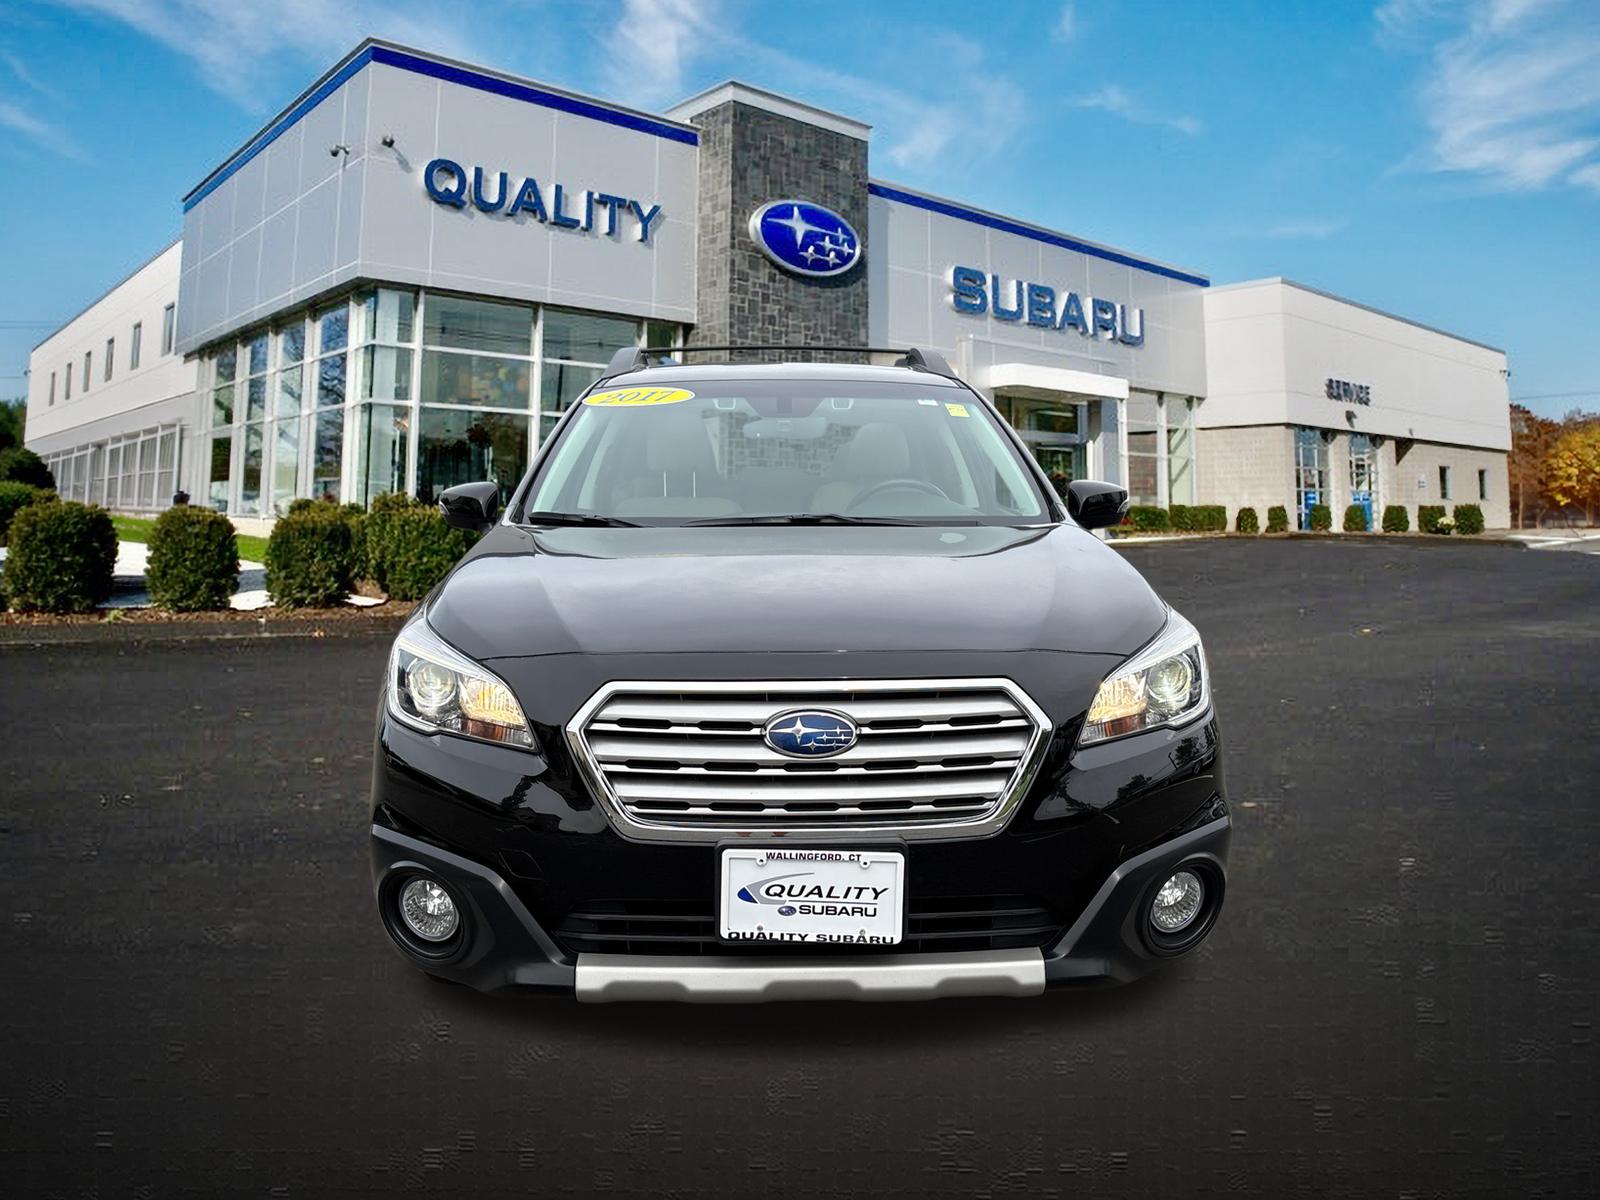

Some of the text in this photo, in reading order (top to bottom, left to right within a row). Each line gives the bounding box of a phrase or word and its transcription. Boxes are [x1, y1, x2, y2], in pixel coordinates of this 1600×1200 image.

[423, 158, 661, 243] QUALITY
[948, 265, 1145, 346] SUBARU
[599, 390, 677, 404] 2017
[848, 853, 862, 862] CT
[764, 883, 889, 901] QUALITY
[798, 904, 878, 917] SUBARU
[727, 931, 894, 944] QUALITY SUBARU
